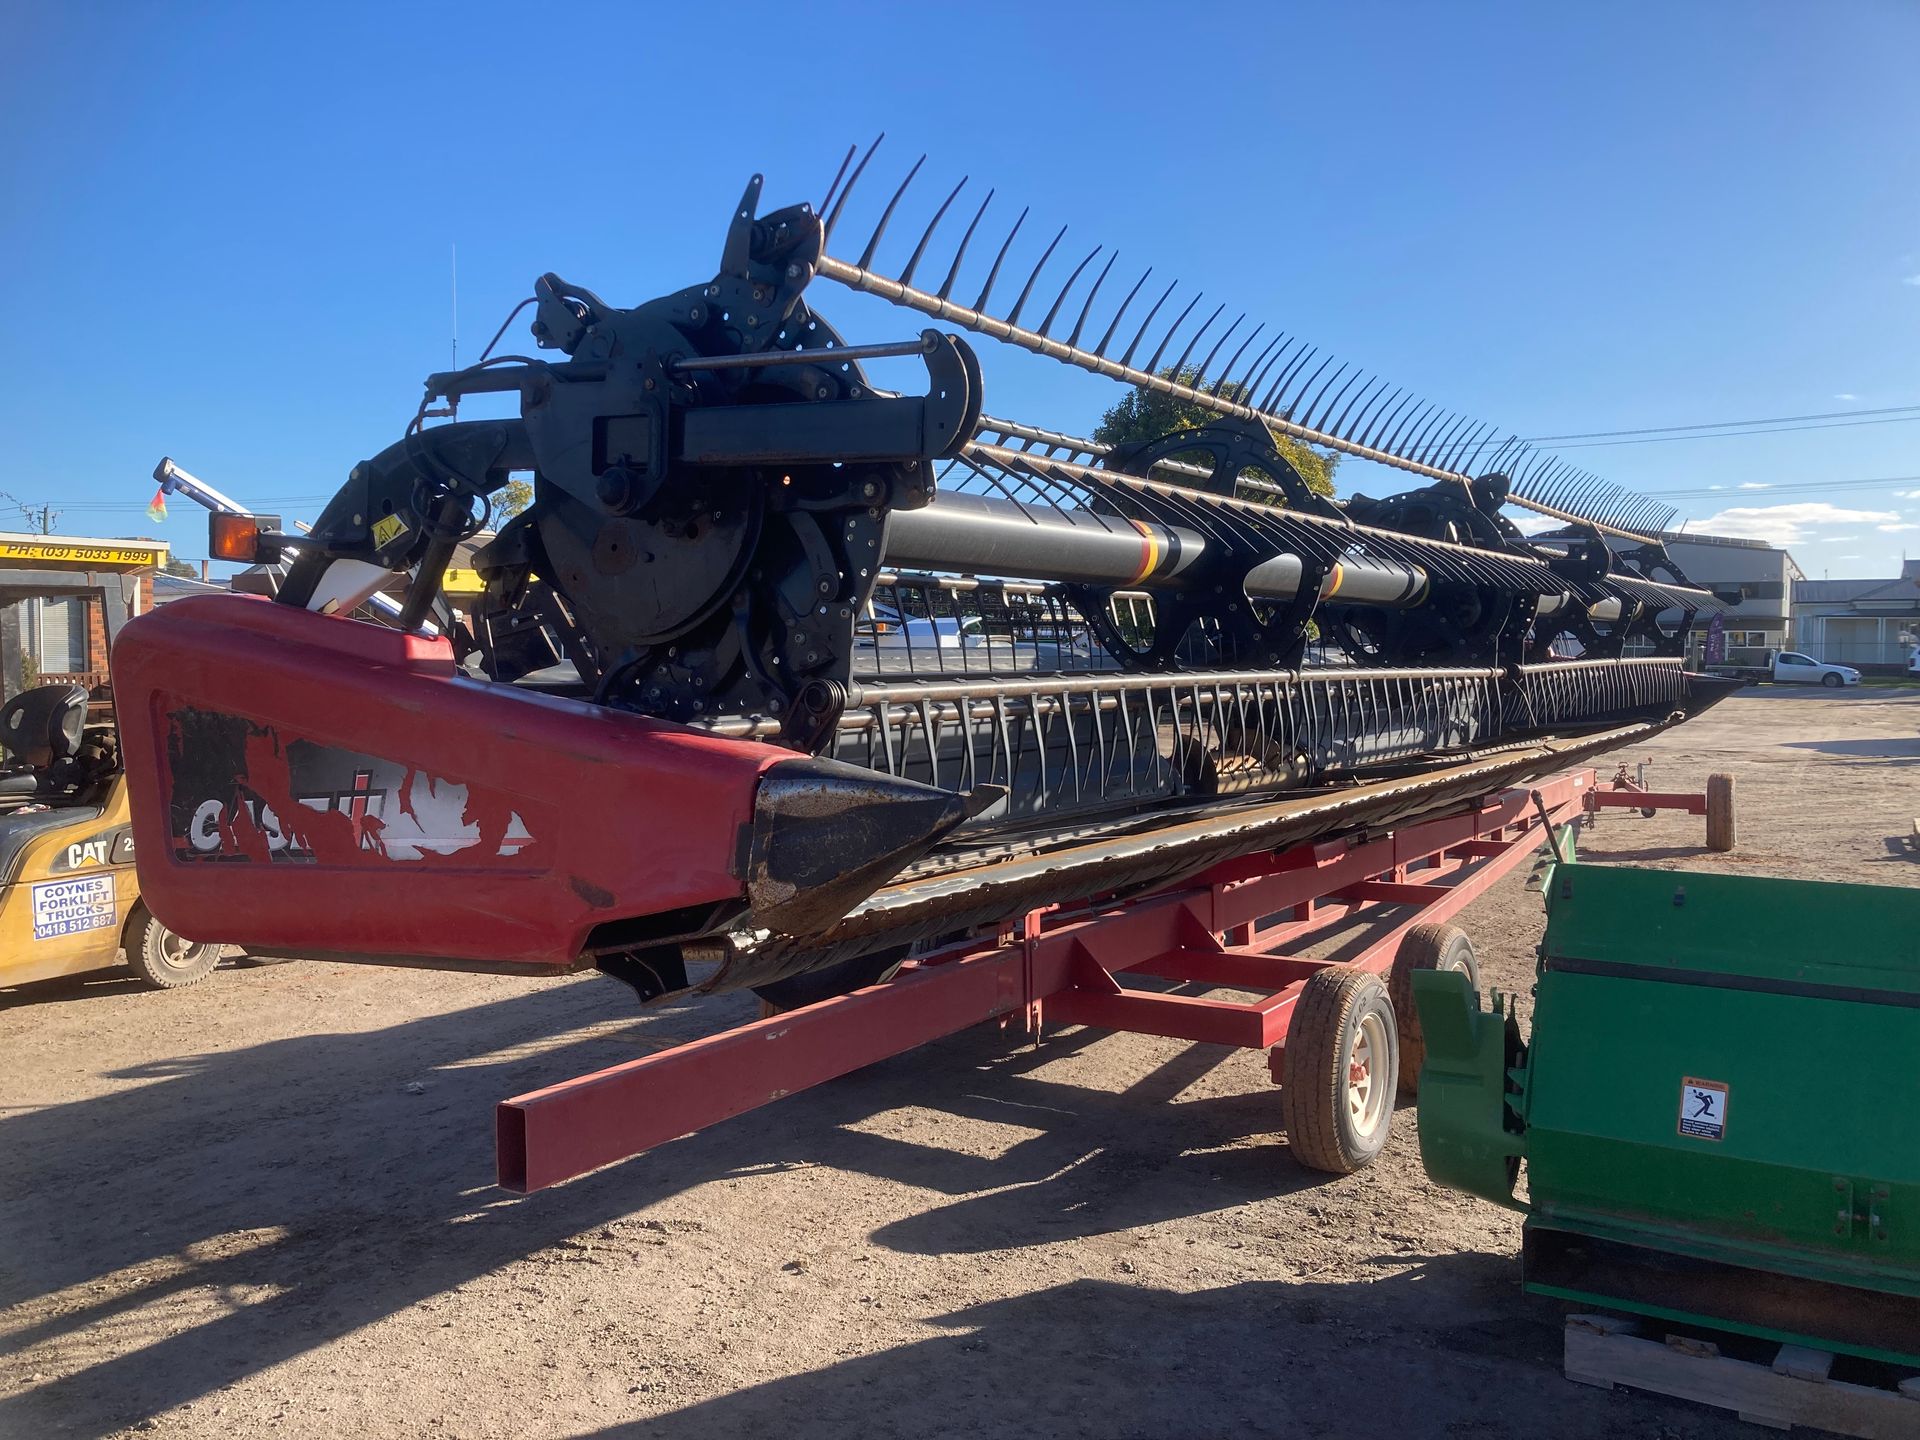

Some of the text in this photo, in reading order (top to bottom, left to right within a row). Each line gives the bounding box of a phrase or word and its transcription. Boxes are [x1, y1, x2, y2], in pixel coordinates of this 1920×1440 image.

[6, 544, 149, 562] PH: (03) 5033 1999
[124, 838, 135, 852] 2
[68, 841, 107, 869] CAT
[44, 880, 104, 898] COYNES
[39, 891, 109, 911] FORKLIFT
[46, 904, 105, 922] TRUCKS
[38, 914, 113, 938] 0418 512 687
